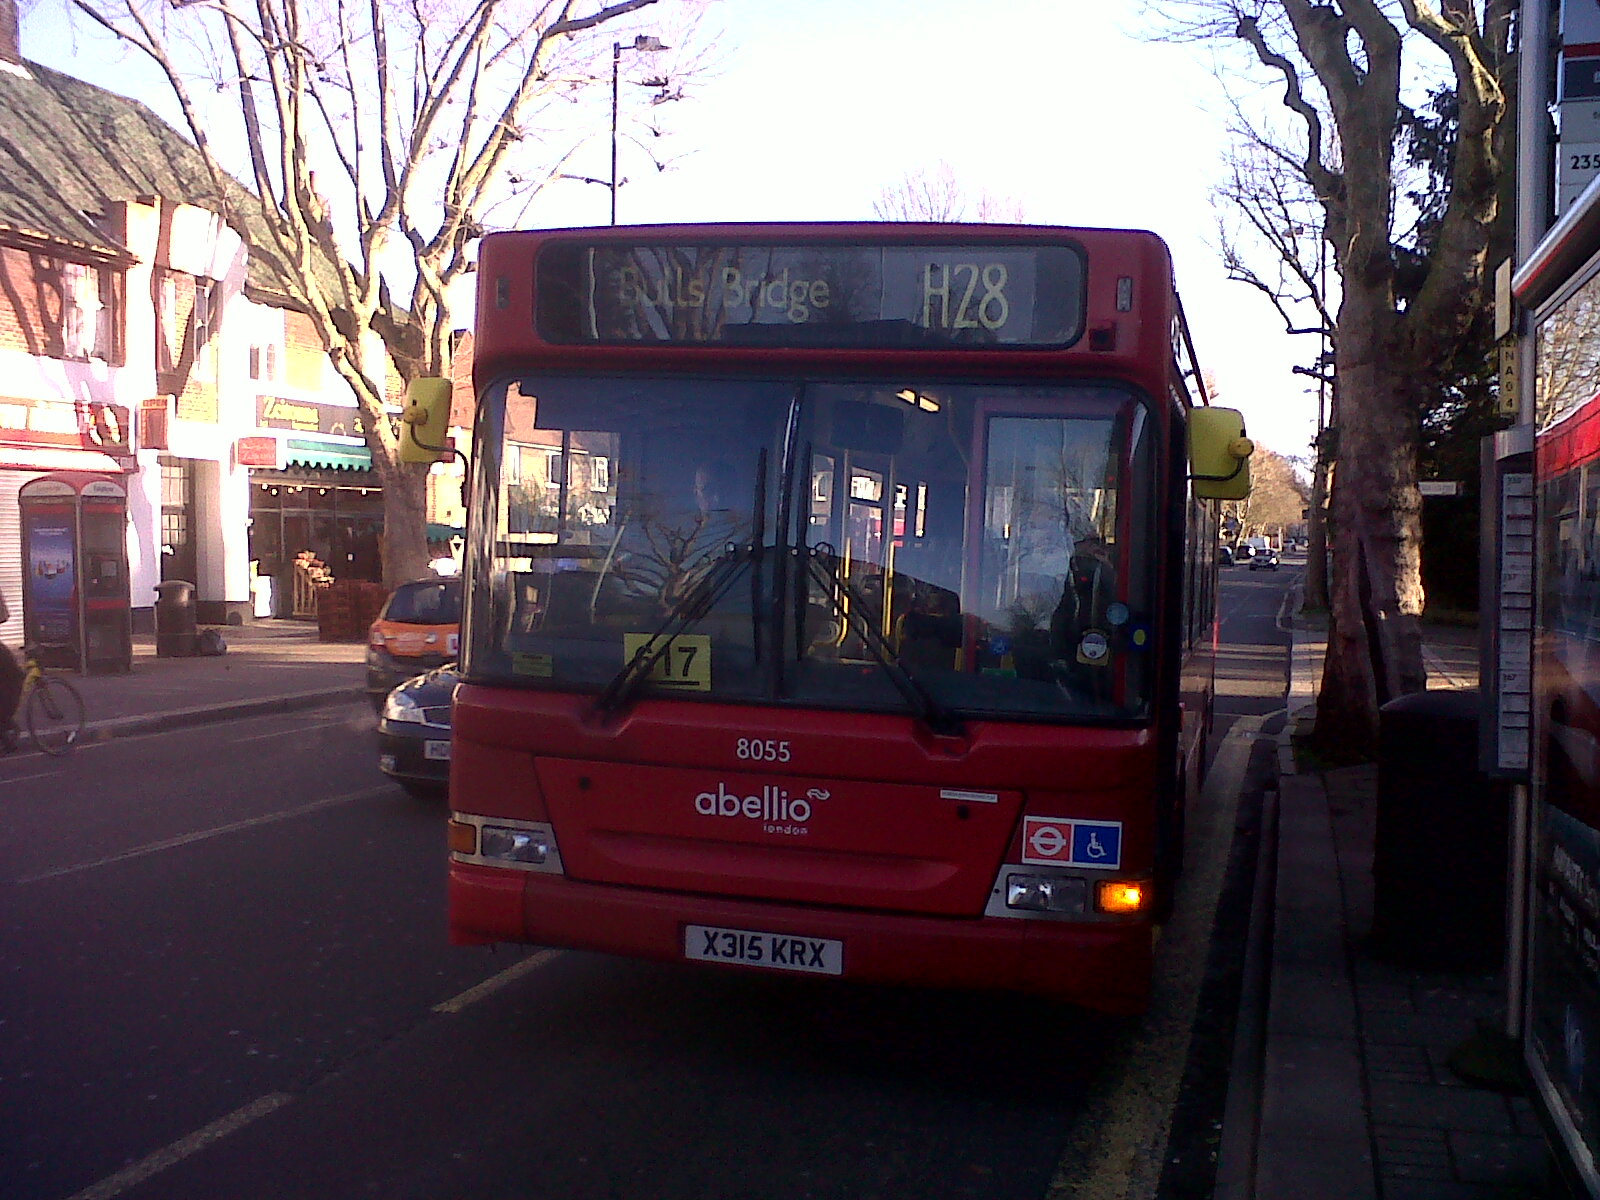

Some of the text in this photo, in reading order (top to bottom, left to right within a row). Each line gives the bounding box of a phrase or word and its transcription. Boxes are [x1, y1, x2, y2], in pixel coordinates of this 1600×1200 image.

[1570, 154, 1600, 169] 235
[722, 266, 830, 324] Bridge
[923, 263, 1009, 329] H28
[736, 738, 791, 762] 8055
[694, 782, 811, 822] abellio
[763, 823, 808, 835] london
[703, 930, 826, 968] X315 KRX
